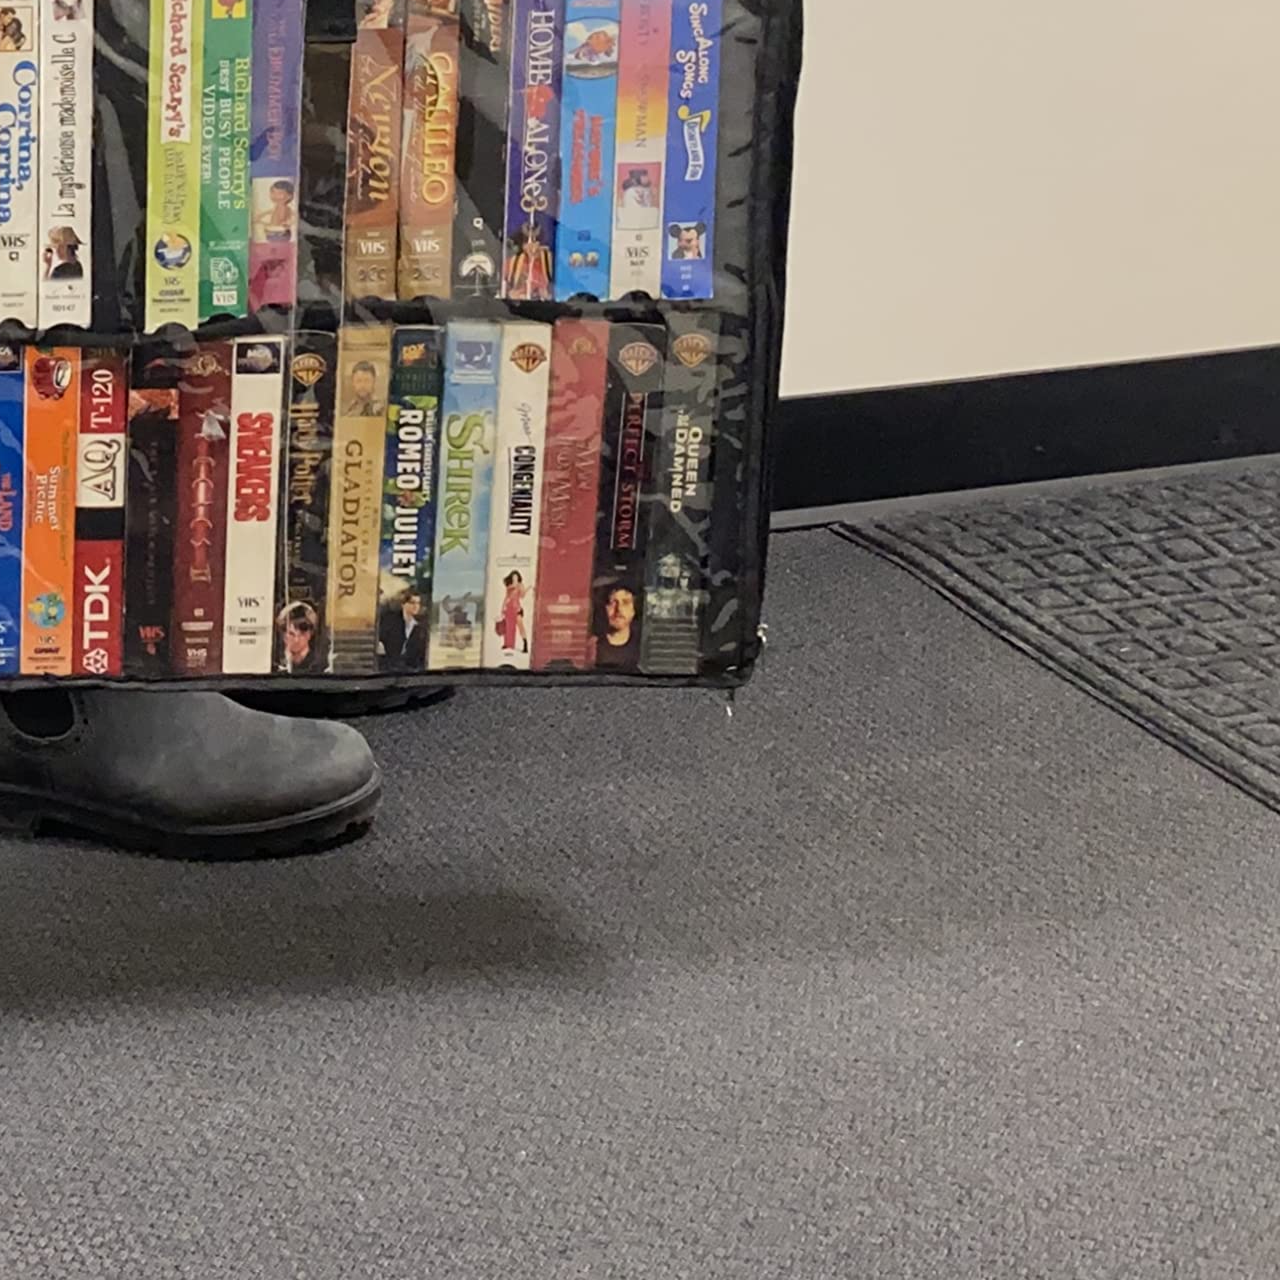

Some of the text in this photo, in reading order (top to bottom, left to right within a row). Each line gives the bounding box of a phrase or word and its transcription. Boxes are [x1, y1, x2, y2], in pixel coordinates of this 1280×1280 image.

[528, 9, 556, 85] HOME
[13, 60, 38, 192] Corrina,
[165, 62, 188, 139] Scarry's
[202, 84, 217, 185] VIDEO EVER!
[218, 59, 232, 210] BEST BUSY PEOPLE
[231, 58, 250, 210] Richard Scarry's
[422, 51, 454, 205] GALILEO
[0, 235, 28, 248] VHS
[51, 202, 76, 218] La
[360, 241, 386, 255] VHS
[414, 239, 440, 254] VHS
[90, 368, 114, 429] T-120
[80, 438, 122, 502] AQ
[233, 411, 275, 523] SNEAKERS
[290, 401, 322, 506] Harry Potter
[396, 409, 424, 490] ROMEO
[670, 426, 690, 513] DAMNED
[685, 426, 703, 496] QUEEN
[35, 473, 48, 524] Picnic
[47, 465, 61, 531] Summer
[338, 438, 366, 600] GLADIATOR
[509, 445, 536, 536] CONGENIALITY
[618, 482, 636, 549] STORM
[391, 506, 420, 577] JULIET
[83, 564, 111, 650] TDK
[238, 596, 260, 609] VHS
